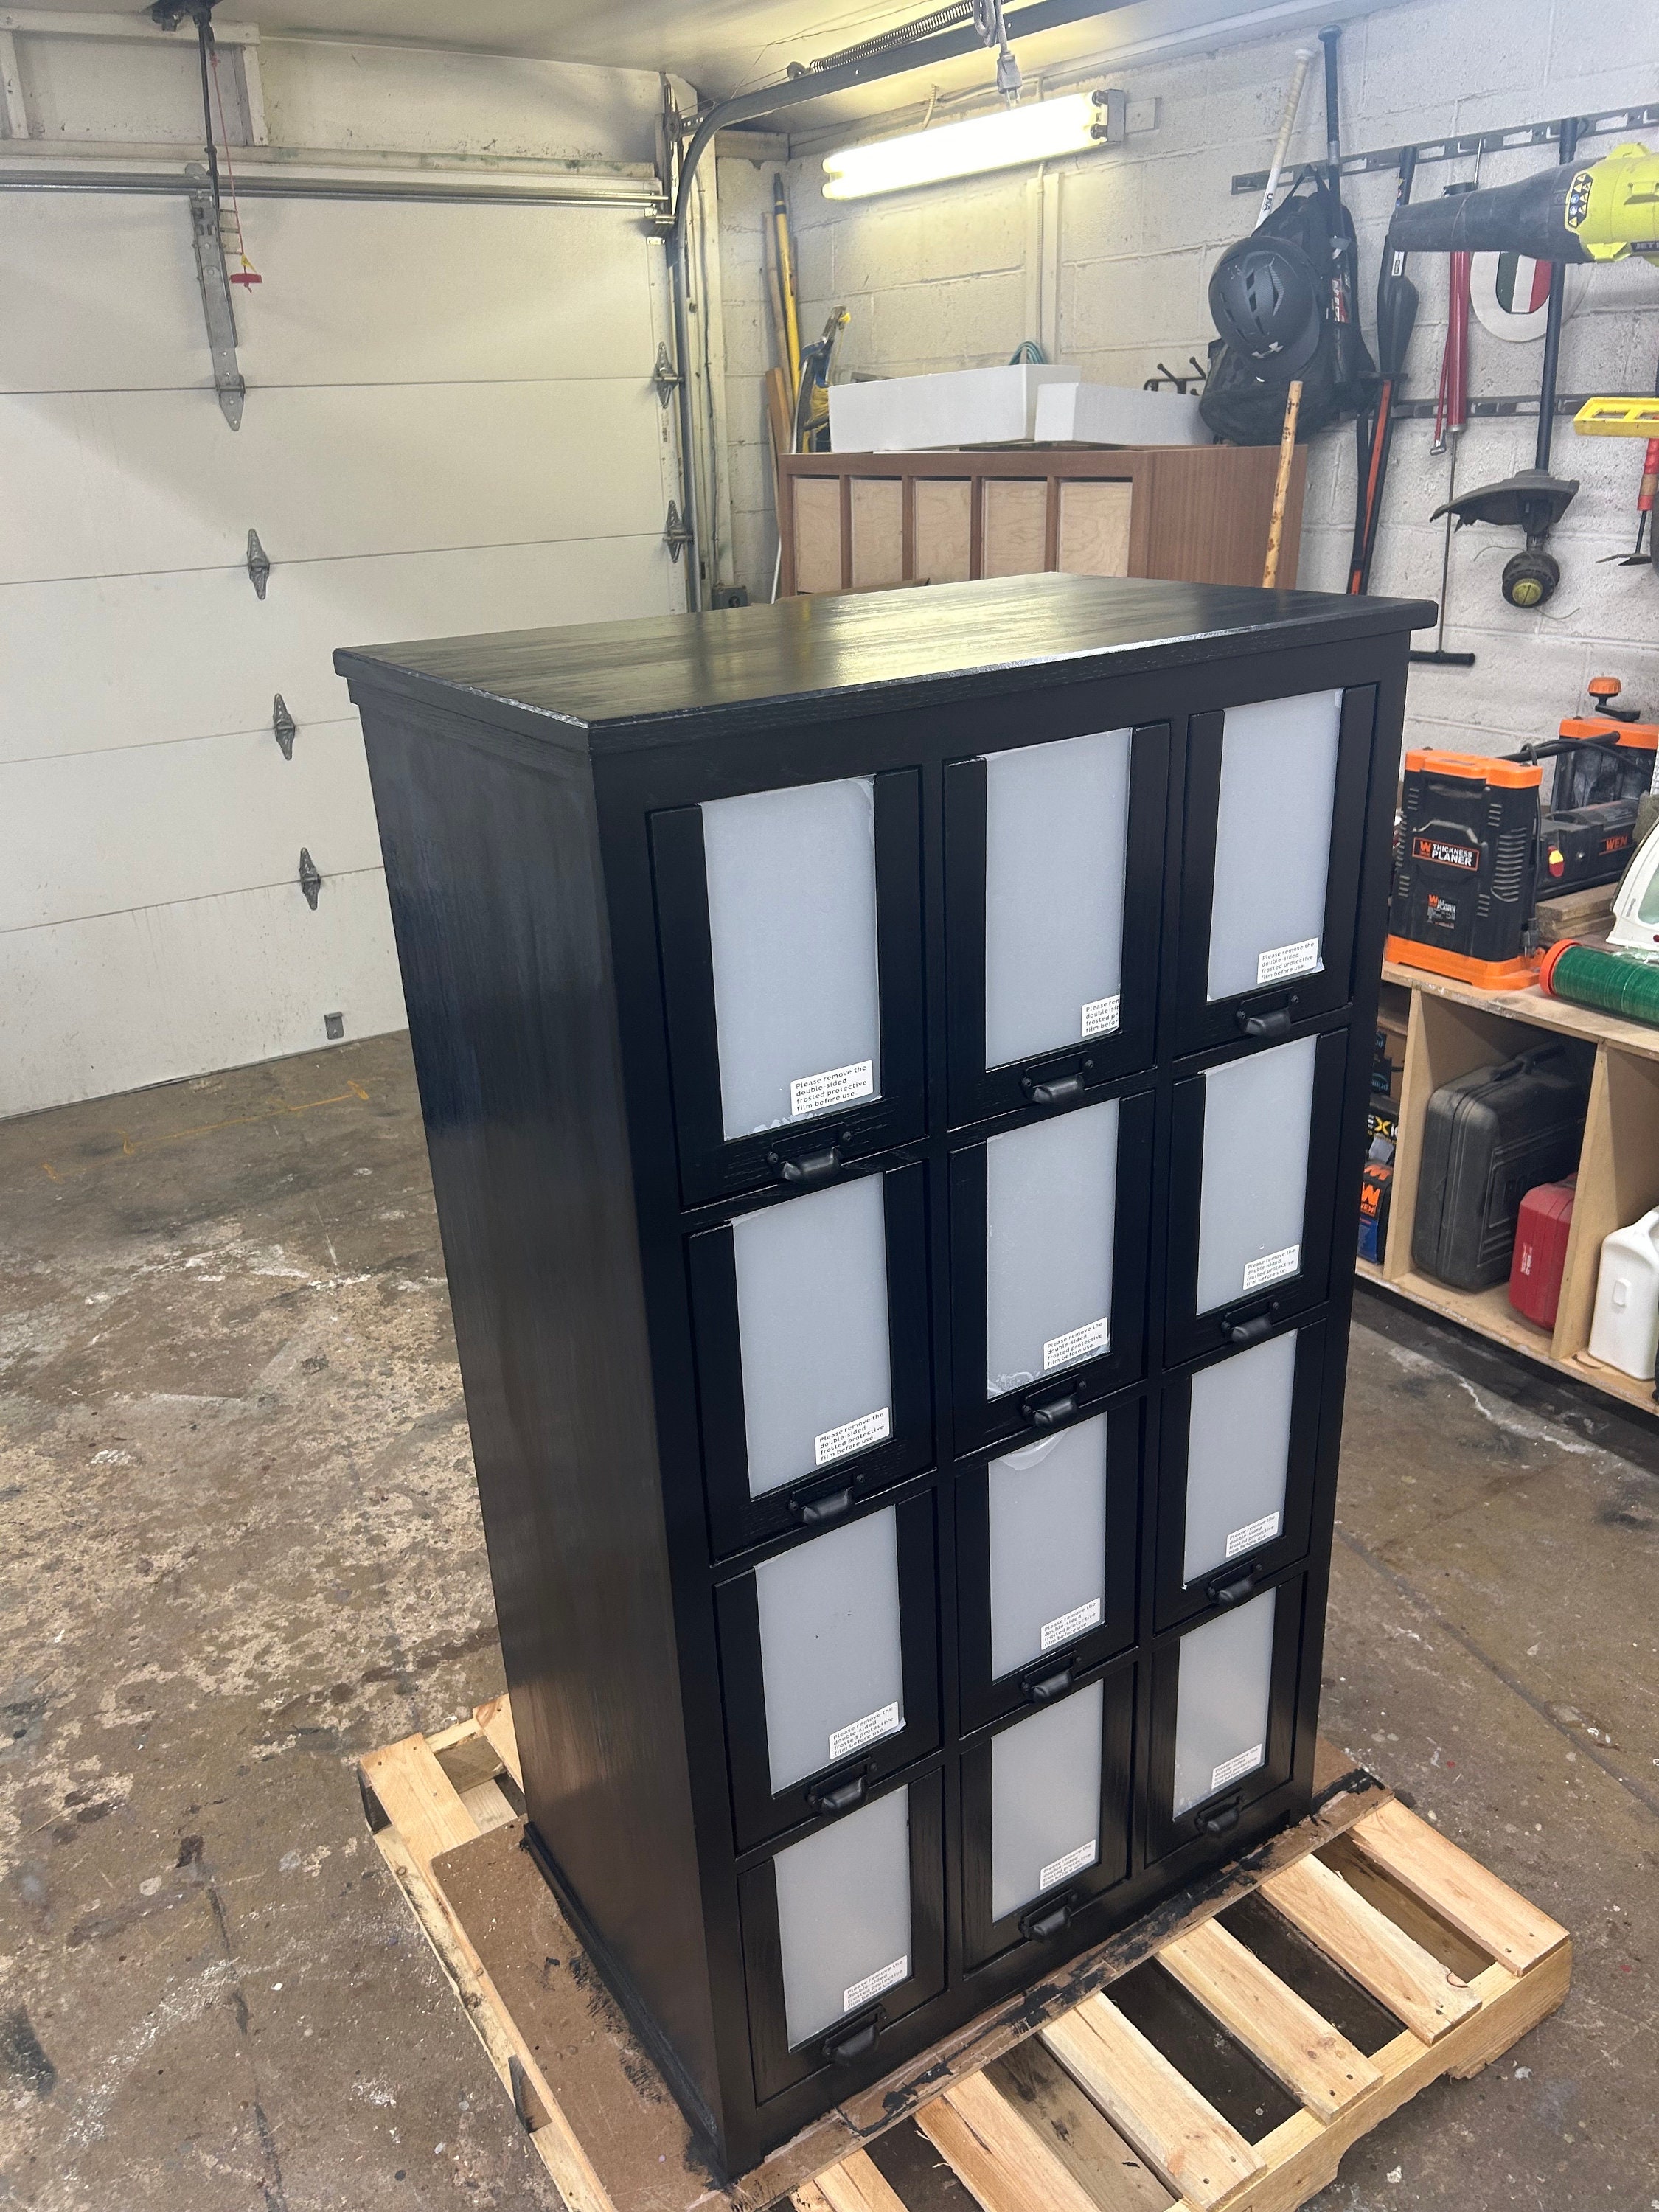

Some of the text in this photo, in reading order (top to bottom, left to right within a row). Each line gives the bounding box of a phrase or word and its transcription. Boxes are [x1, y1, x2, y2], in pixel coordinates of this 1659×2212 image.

[1433, 844, 1472, 858] THICKNESS
[1606, 835, 1627, 851] WEN
[1431, 849, 1472, 866] PLANER
[1262, 952, 1281, 961] Please
[1281, 945, 1303, 955] remove
[1261, 955, 1312, 973] frosted protective
[1273, 967, 1293, 976] before
[1085, 1002, 1107, 1012] Please
[1085, 1014, 1109, 1026] frosted
[1101, 1020, 1119, 1028] befor
[796, 1078, 821, 1089] Please
[823, 1069, 852, 1081] remove
[796, 1080, 866, 1104] frosted protective
[796, 1103, 812, 1111] film
[814, 1096, 840, 1106] before
[1047, 1338, 1067, 1349] Please
[1068, 1326, 1091, 1339] remove
[1047, 1334, 1102, 1360] frosted protective
[1047, 1358, 1060, 1366] film
[1061, 1349, 1081, 1360] before
[819, 1412, 883, 1442] Please remove the
[820, 1425, 884, 1455] frosted protective
[821, 1453, 835, 1461] film
[836, 1441, 860, 1454] before
[1044, 1619, 1062, 1631] Please
[1064, 1608, 1085, 1621] remove
[1044, 1613, 1095, 1641] frosted protective
[1044, 1638, 1056, 1646] film
[1057, 1628, 1076, 1640] before
[833, 1726, 855, 1739] Please
[856, 1713, 880, 1728] remove
[834, 1717, 893, 1750] frosted protective
[834, 1747, 847, 1756] film
[849, 1734, 871, 1747] before
